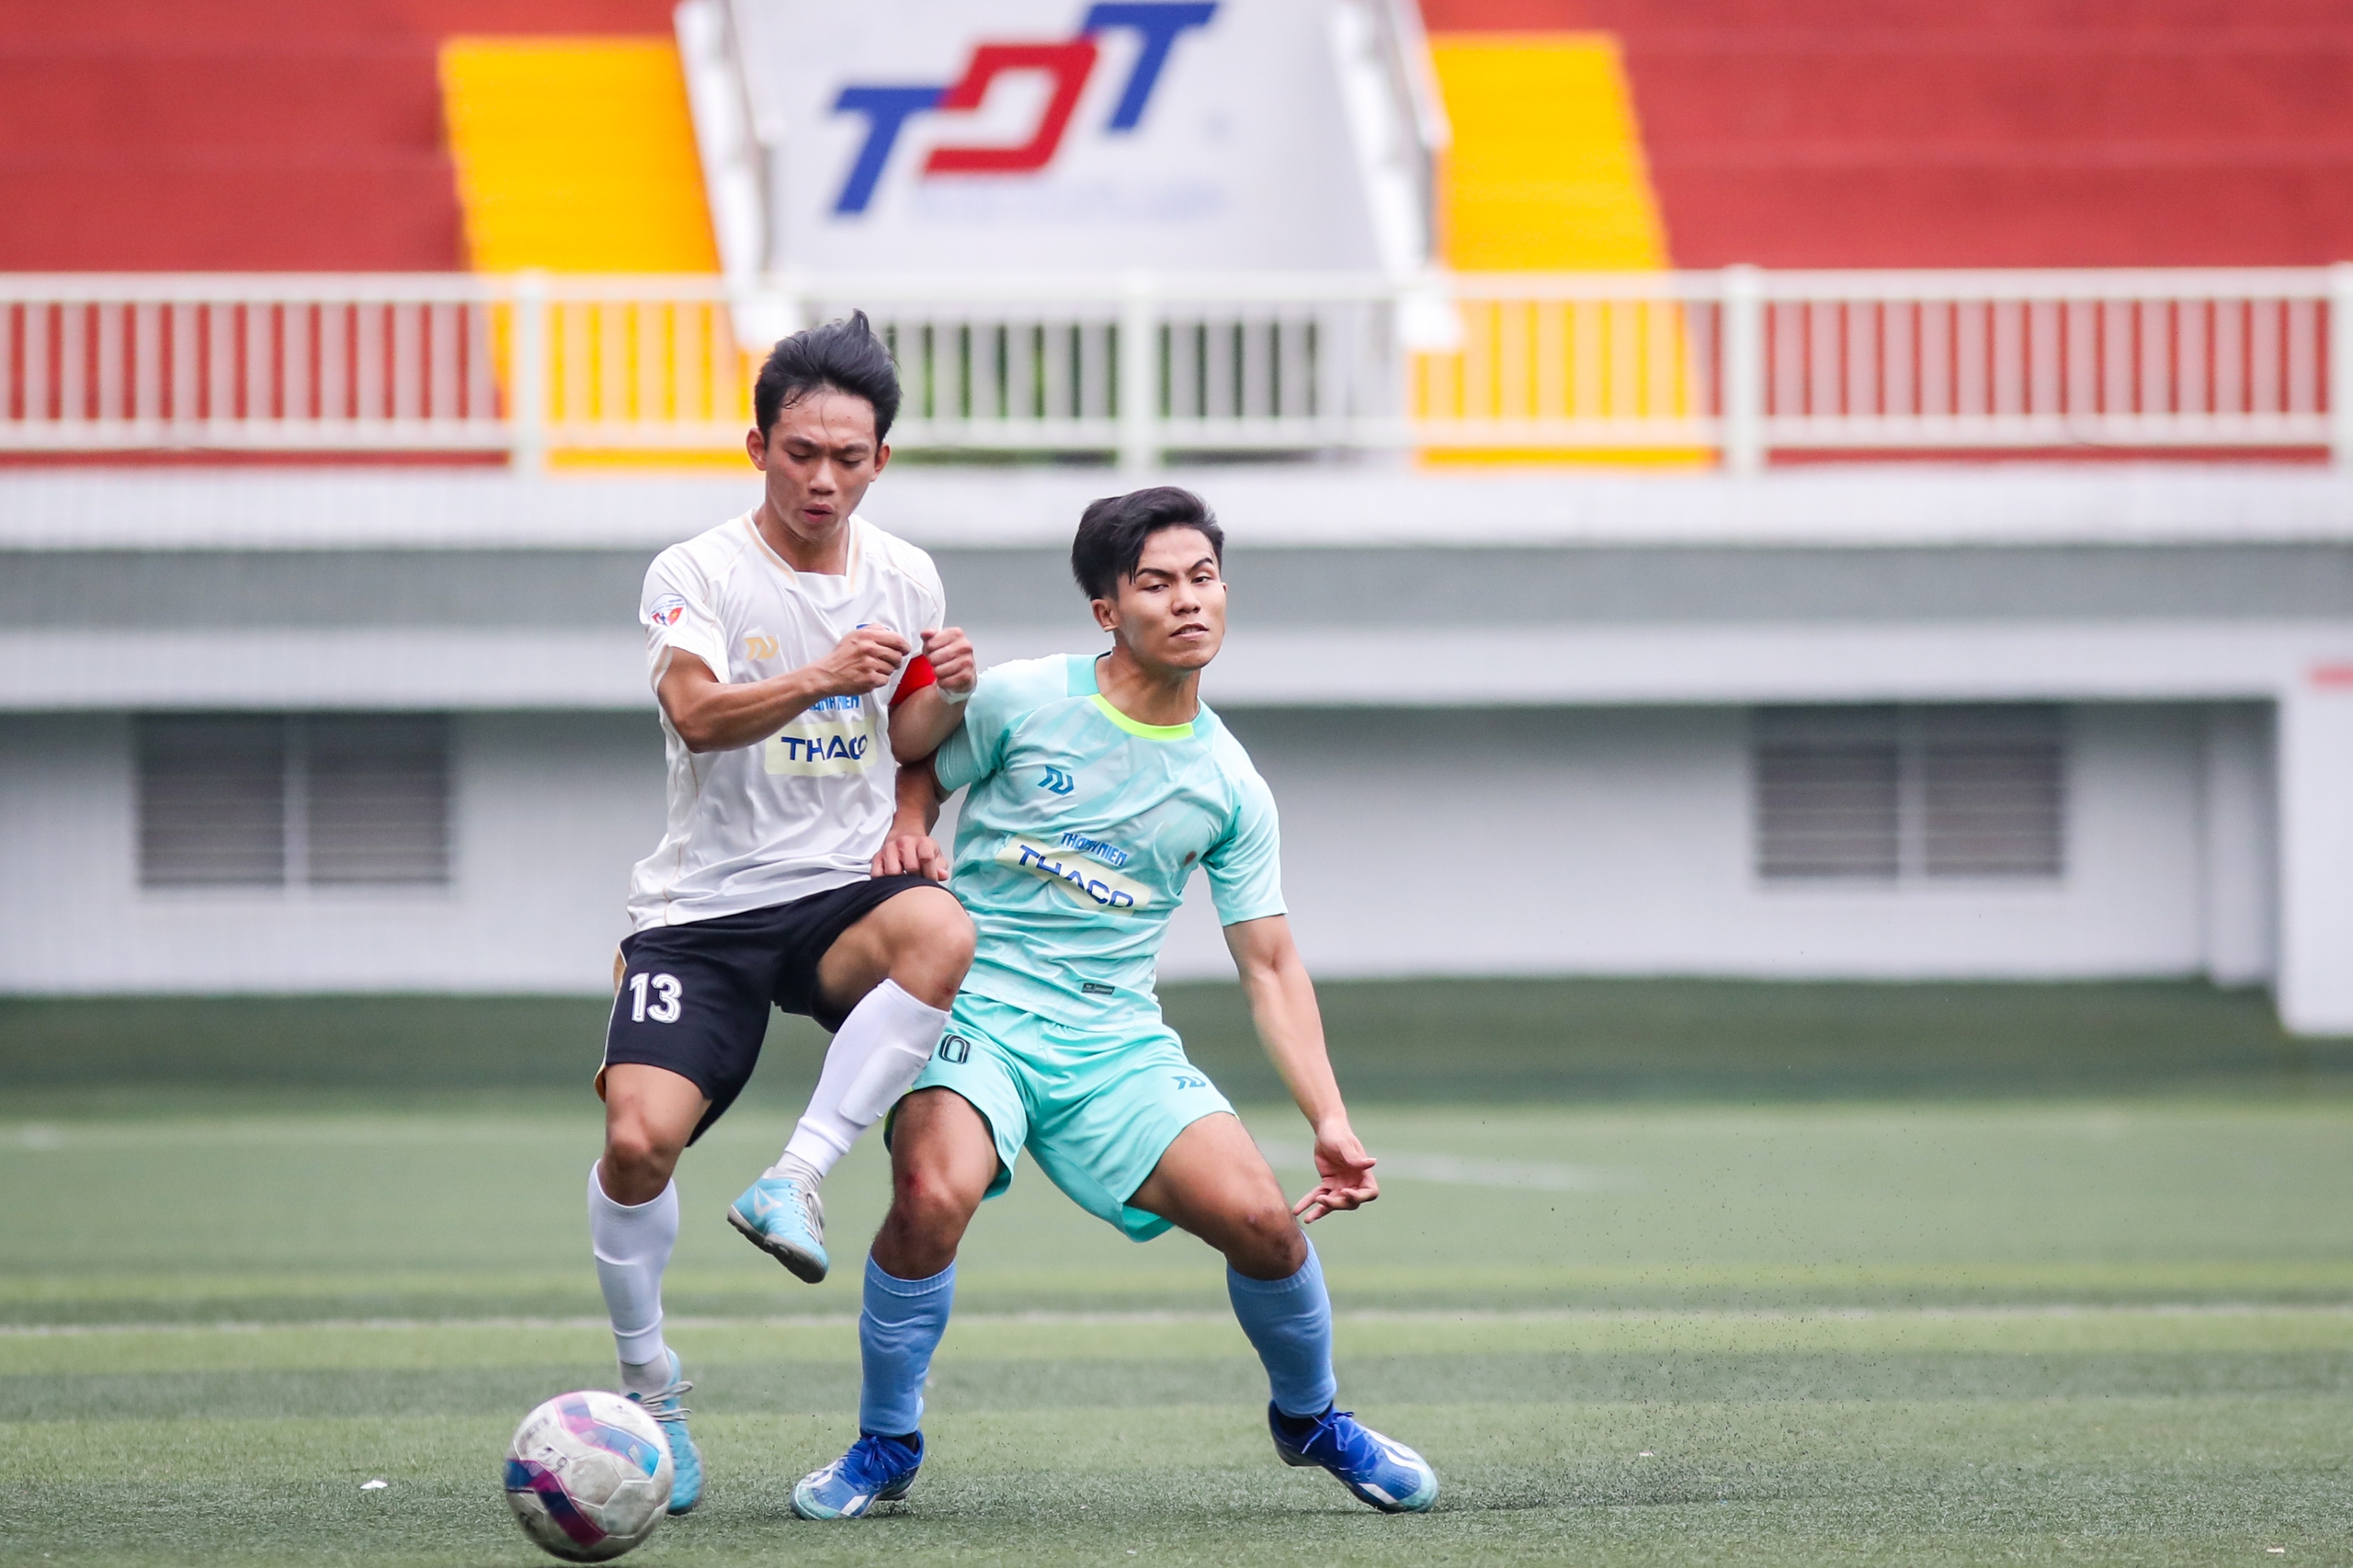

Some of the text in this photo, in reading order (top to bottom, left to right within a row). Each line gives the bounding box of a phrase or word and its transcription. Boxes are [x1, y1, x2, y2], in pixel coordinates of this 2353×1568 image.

[780, 734, 868, 762] THACO
[630, 972, 683, 1024] 13
[929, 1034, 971, 1064] 0
